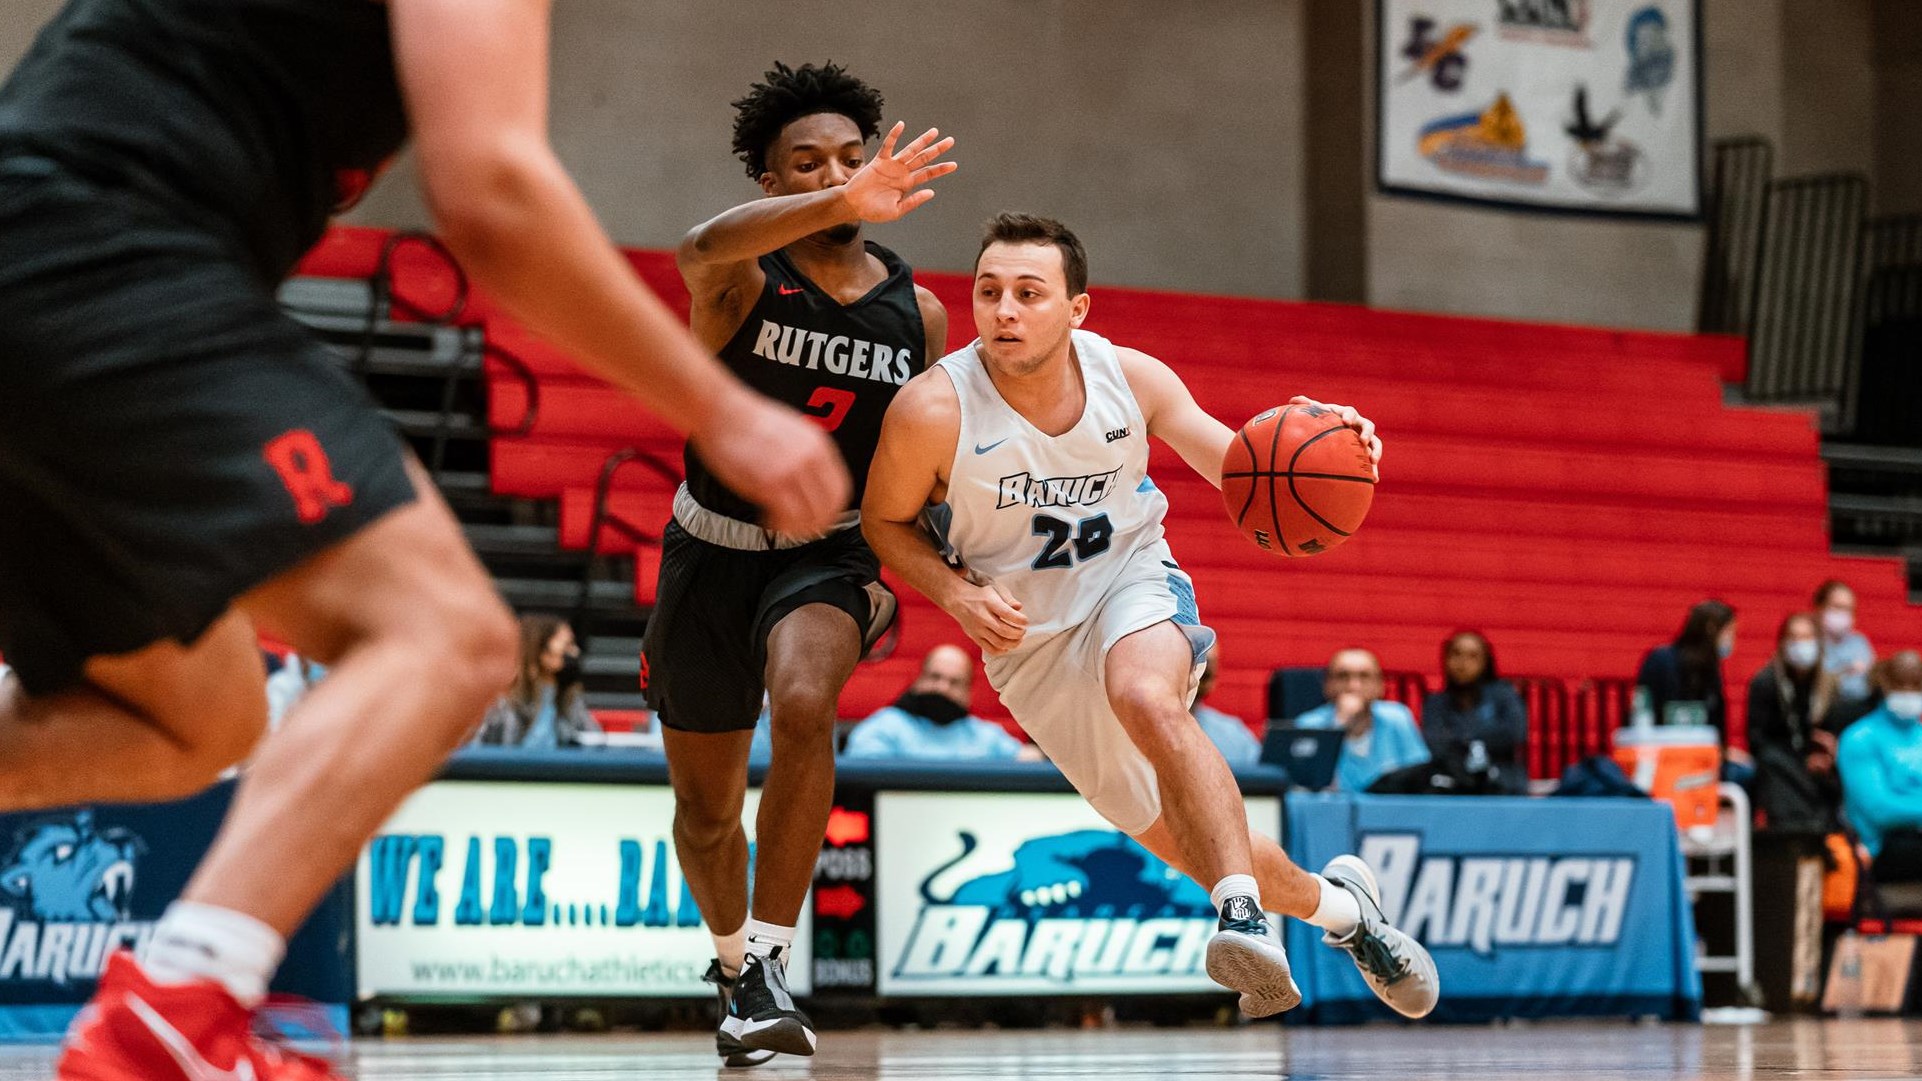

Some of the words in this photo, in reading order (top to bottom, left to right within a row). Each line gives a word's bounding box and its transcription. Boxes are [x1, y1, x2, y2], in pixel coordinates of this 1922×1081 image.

[752, 319, 912, 386] RUTGERS
[262, 428, 354, 524] R
[996, 463, 1124, 509] BARUCH
[1031, 512, 1114, 571] 20
[371, 835, 443, 924] WE
[1356, 831, 1637, 957] BARUCH
